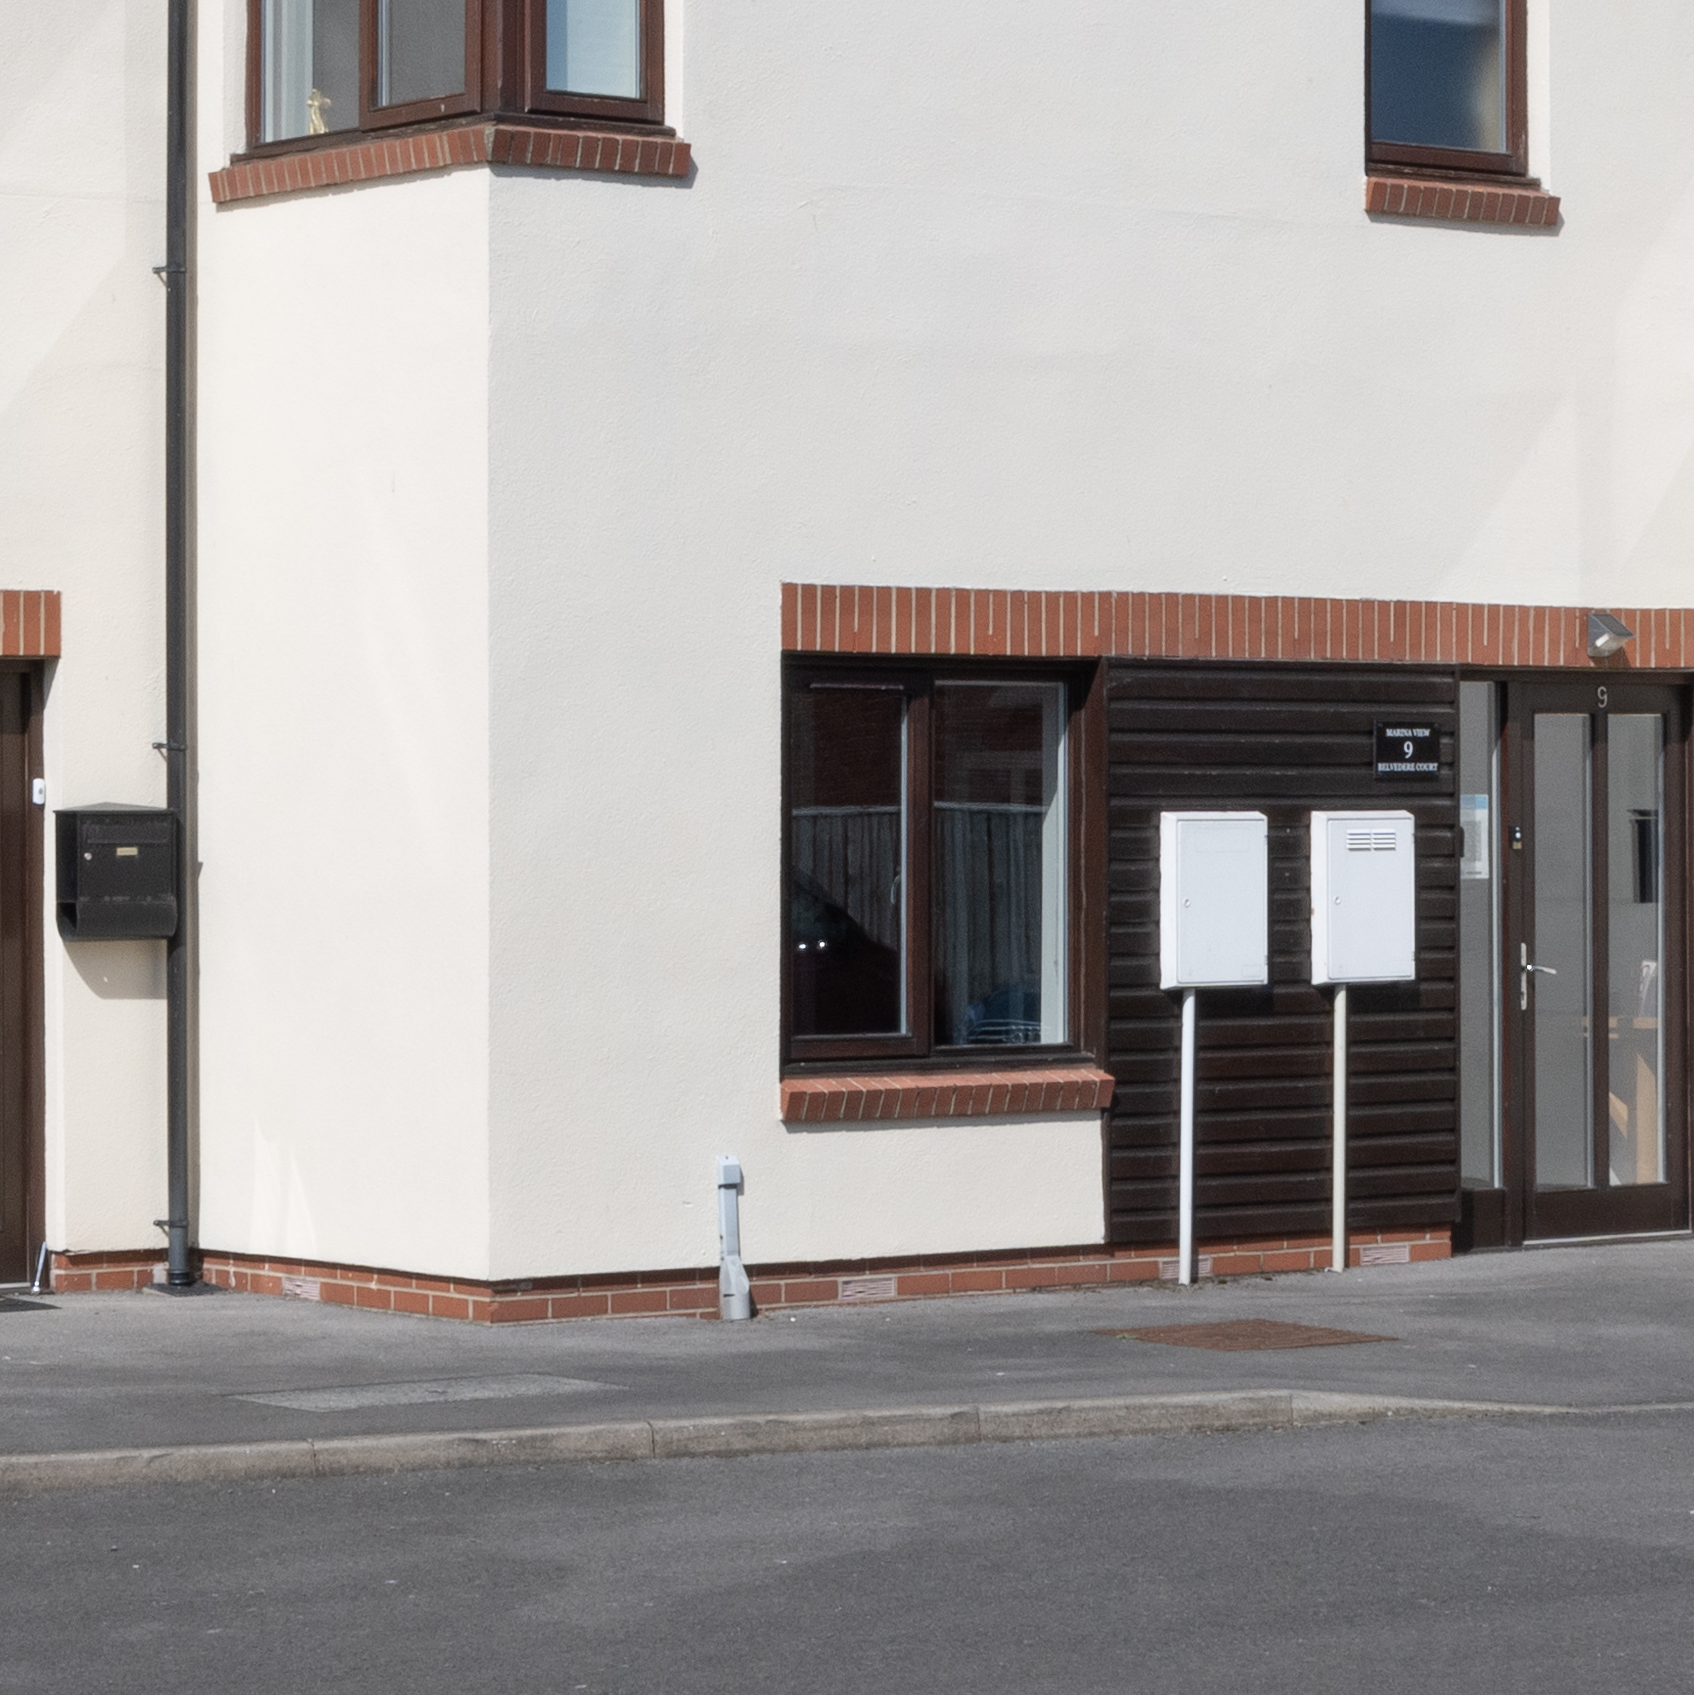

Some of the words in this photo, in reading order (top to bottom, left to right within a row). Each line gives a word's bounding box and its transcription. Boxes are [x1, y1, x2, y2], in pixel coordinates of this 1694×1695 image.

[1597, 686, 1608, 708] 9
[1386, 728, 1412, 737] MARINA
[1413, 728, 1431, 737] VIEW
[1403, 741, 1414, 759] 9
[1378, 763, 1415, 772] BELVEDERE
[1415, 763, 1438, 772] COURT
